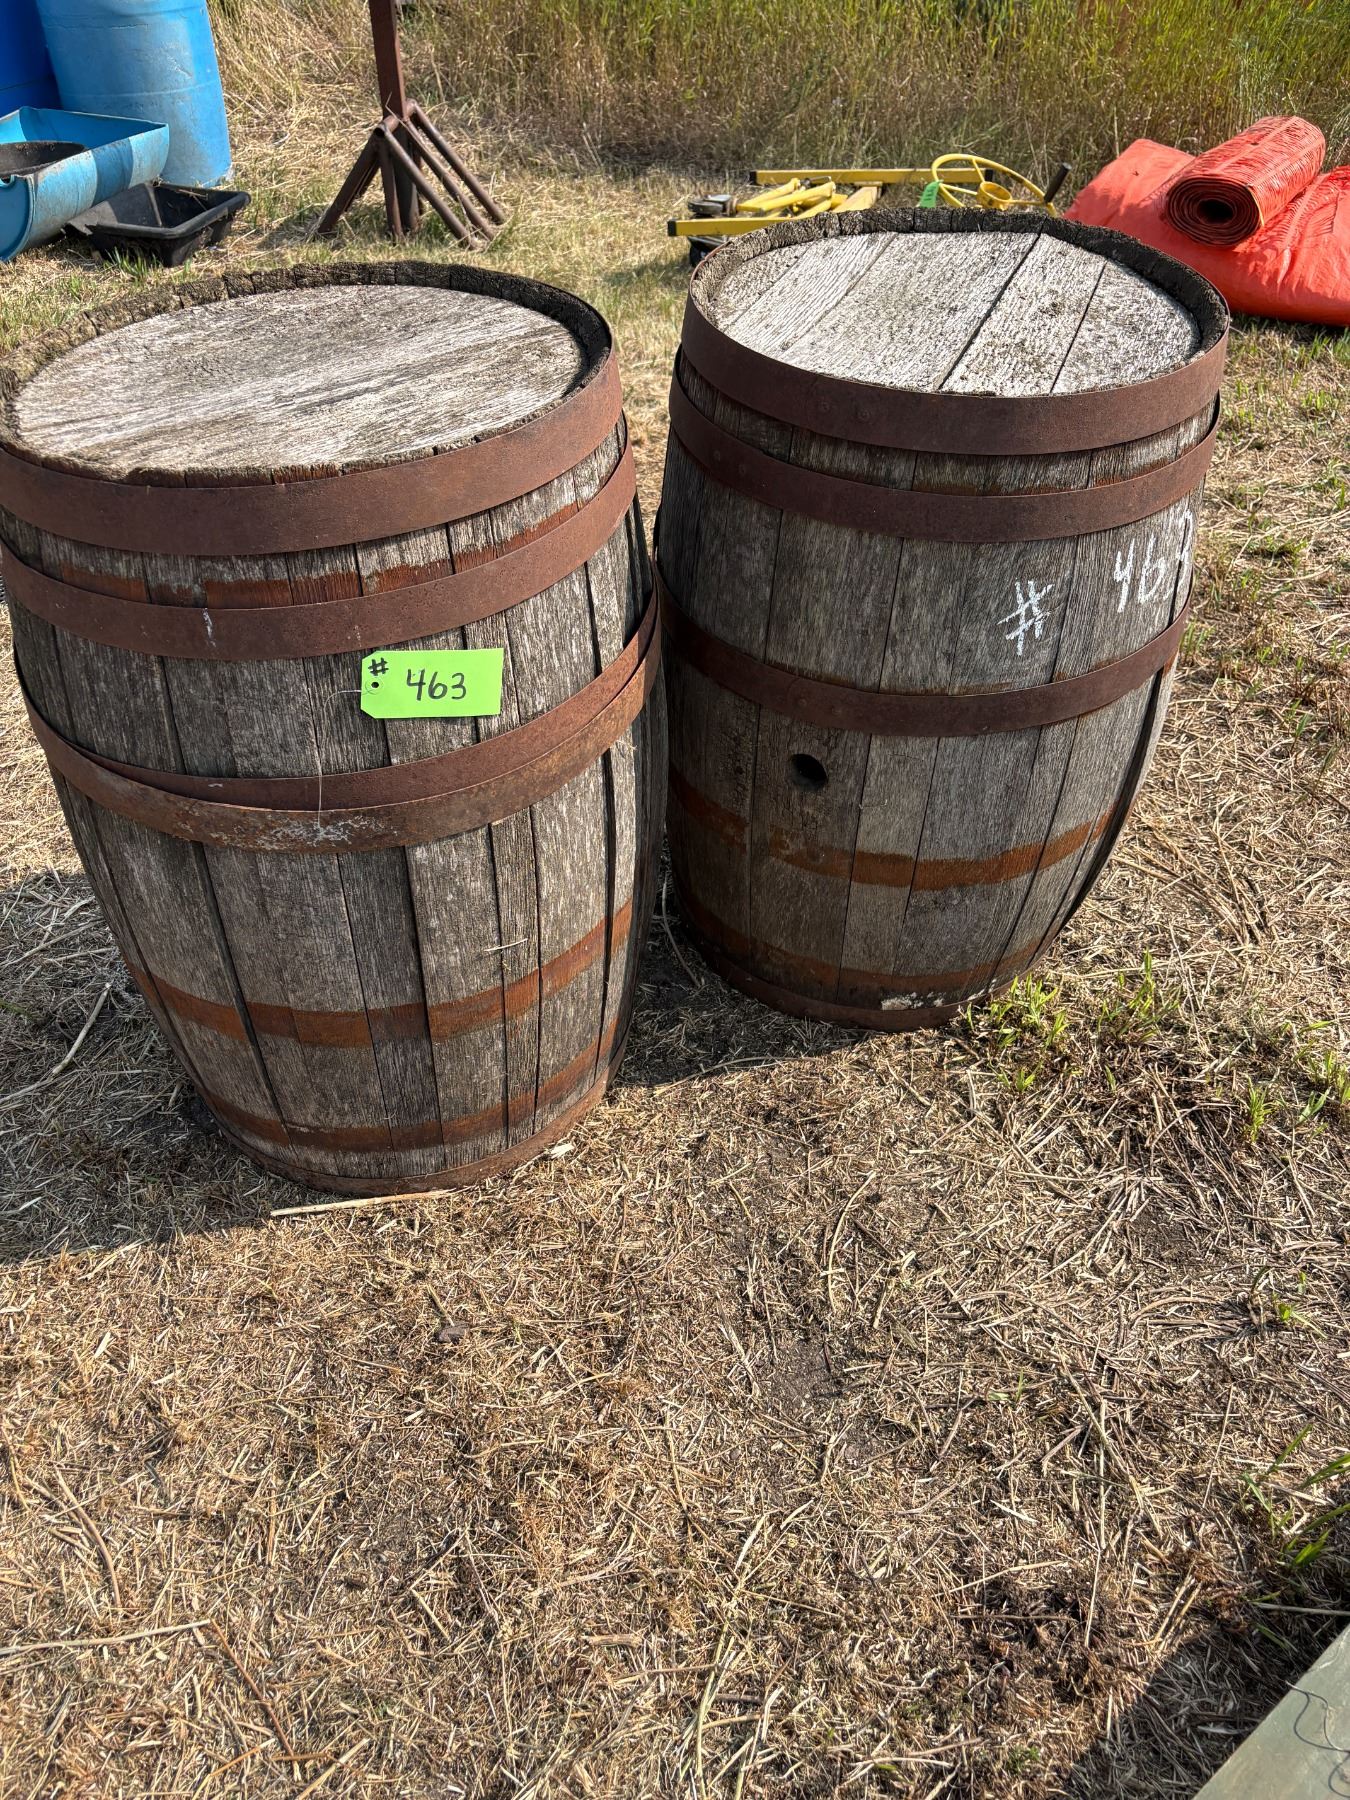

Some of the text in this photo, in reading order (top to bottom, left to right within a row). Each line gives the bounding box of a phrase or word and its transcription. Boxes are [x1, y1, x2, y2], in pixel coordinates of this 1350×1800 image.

[997, 577, 1055, 656] #
[368, 657, 467, 701] # 463
